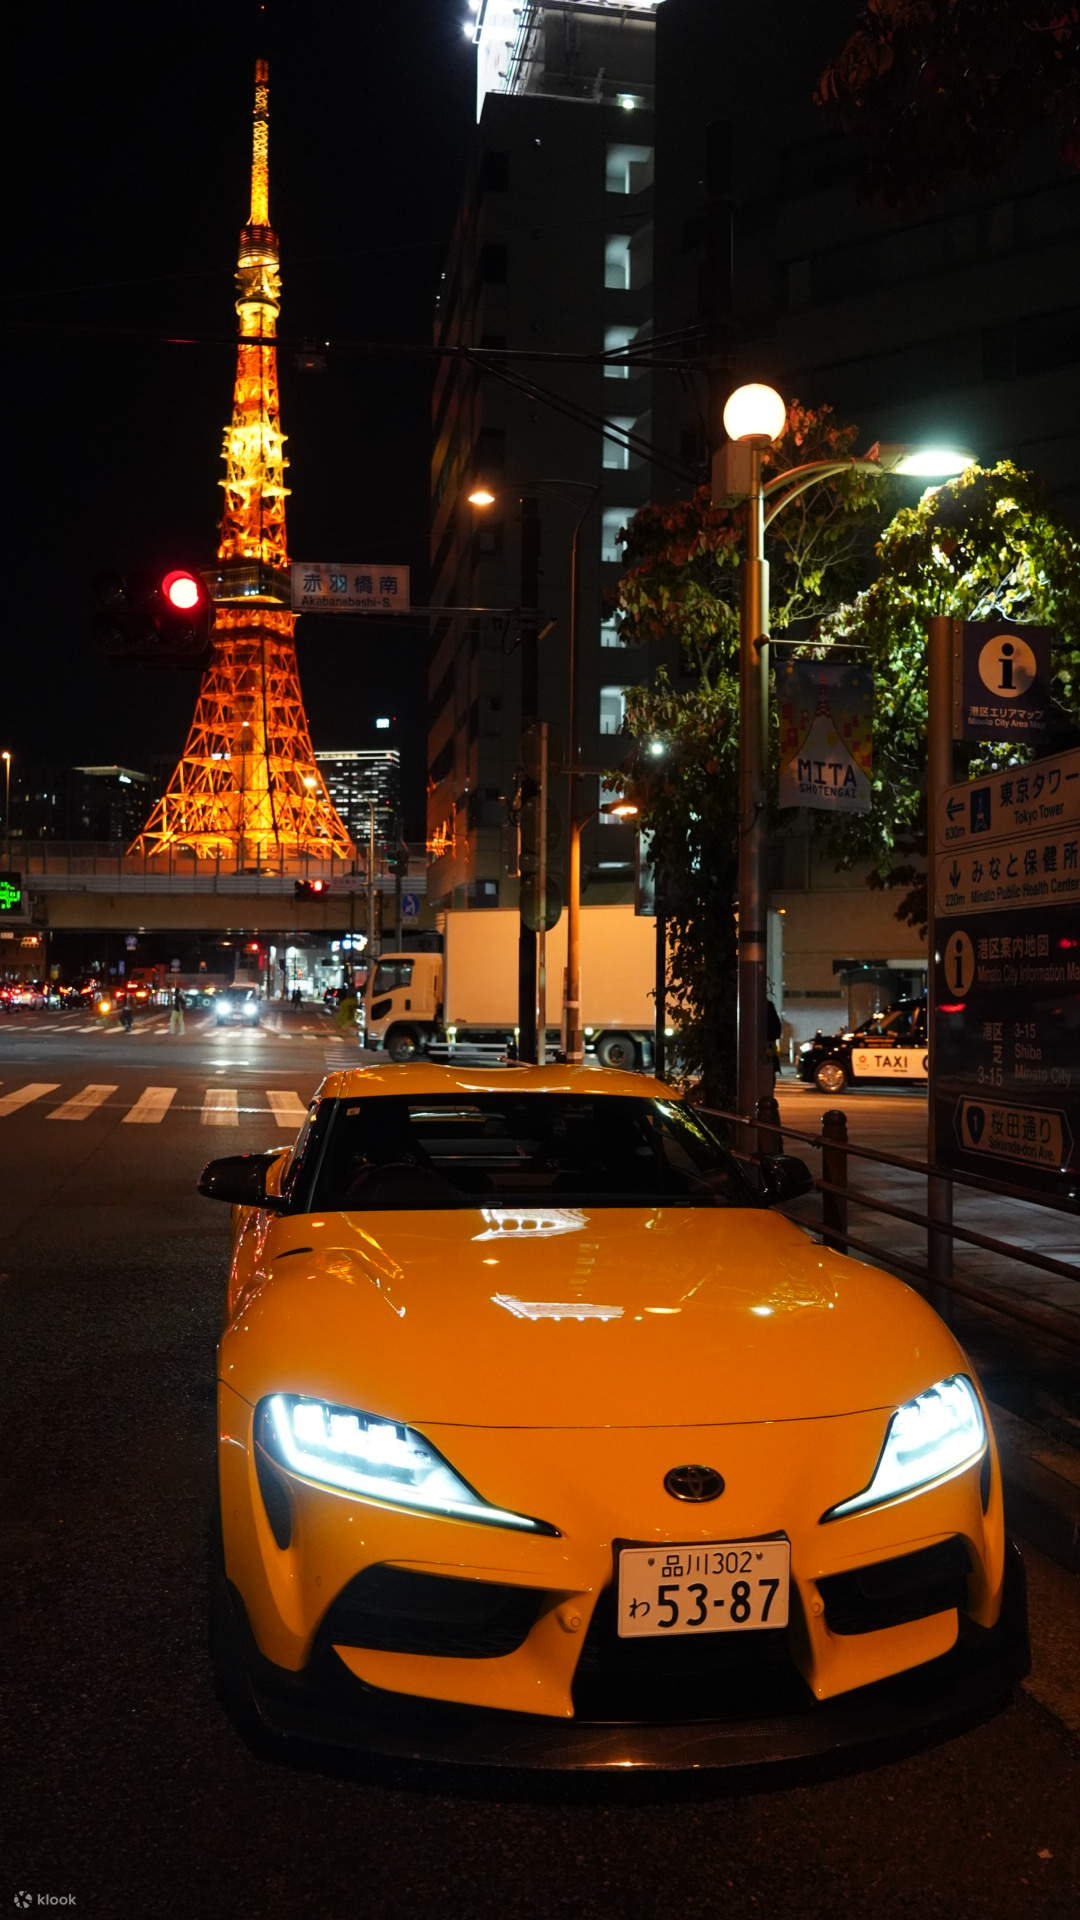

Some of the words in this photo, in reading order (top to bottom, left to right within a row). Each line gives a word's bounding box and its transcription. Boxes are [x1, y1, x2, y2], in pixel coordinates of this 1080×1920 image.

[303, 574, 398, 595] 赤羽橋南
[995, 719, 1009, 729] City
[1011, 720, 1028, 728] Area
[797, 759, 857, 787] MITA
[800, 784, 857, 798] SHOTENGAI
[1000, 768, 1079, 807] 東京タワー
[1014, 807, 1038, 825] Tokyo
[1039, 803, 1064, 819] Tower
[971, 840, 1079, 883] みなと保健所
[971, 886, 995, 903] Minato
[997, 884, 1021, 899] Public
[1022, 879, 1048, 897] Health
[1050, 877, 1080, 893] Center
[1002, 963, 1019, 987] City
[1014, 1022, 1036, 1040] 3-15
[874, 1055, 908, 1068] TAXI
[1014, 1042, 1043, 1061] Shiba
[977, 1064, 1003, 1087] 3-15
[1050, 1066, 1072, 1088] City
[991, 1110, 1052, 1144] 桜田通り
[628, 1598, 650, 1619] わ
[657, 1578, 779, 1628] 53-87
